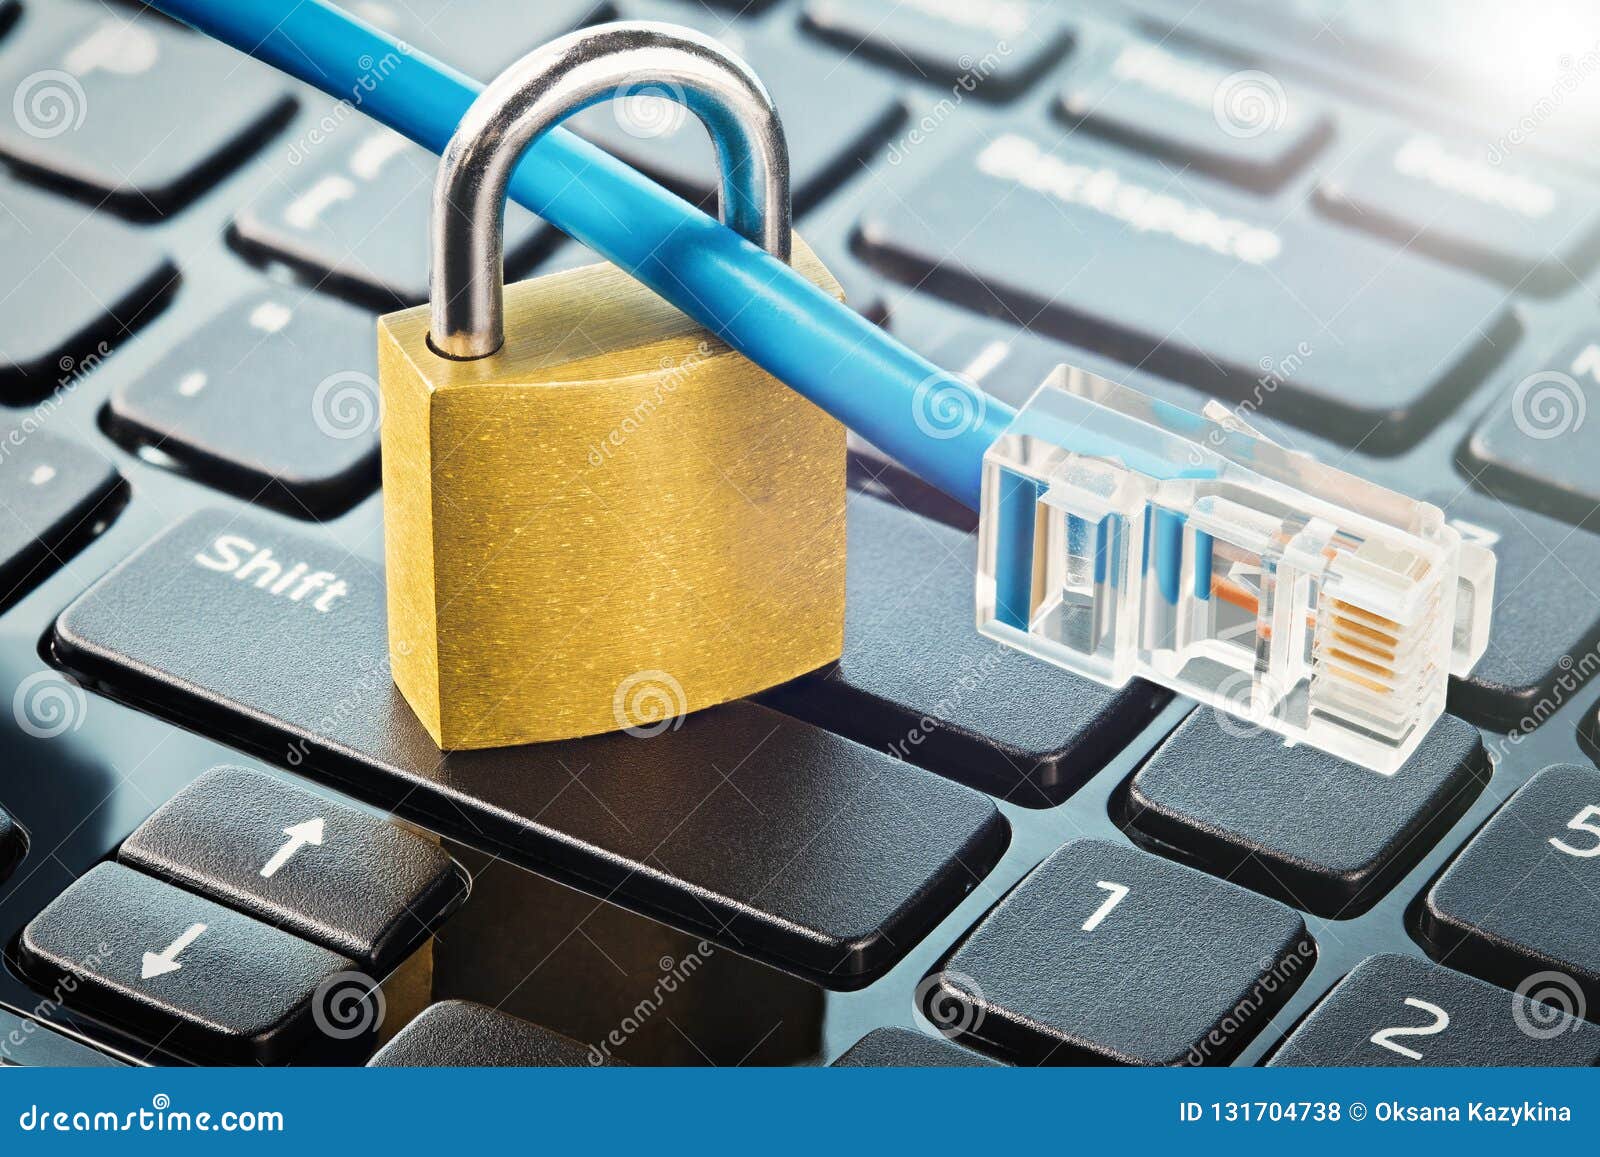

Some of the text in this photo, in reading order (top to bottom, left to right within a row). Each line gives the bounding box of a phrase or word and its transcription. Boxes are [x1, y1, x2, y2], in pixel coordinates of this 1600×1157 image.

[194, 535, 348, 612] Shift
[1548, 804, 1600, 858] 5
[1082, 880, 1130, 932] 1
[1370, 997, 1450, 1060] 2
